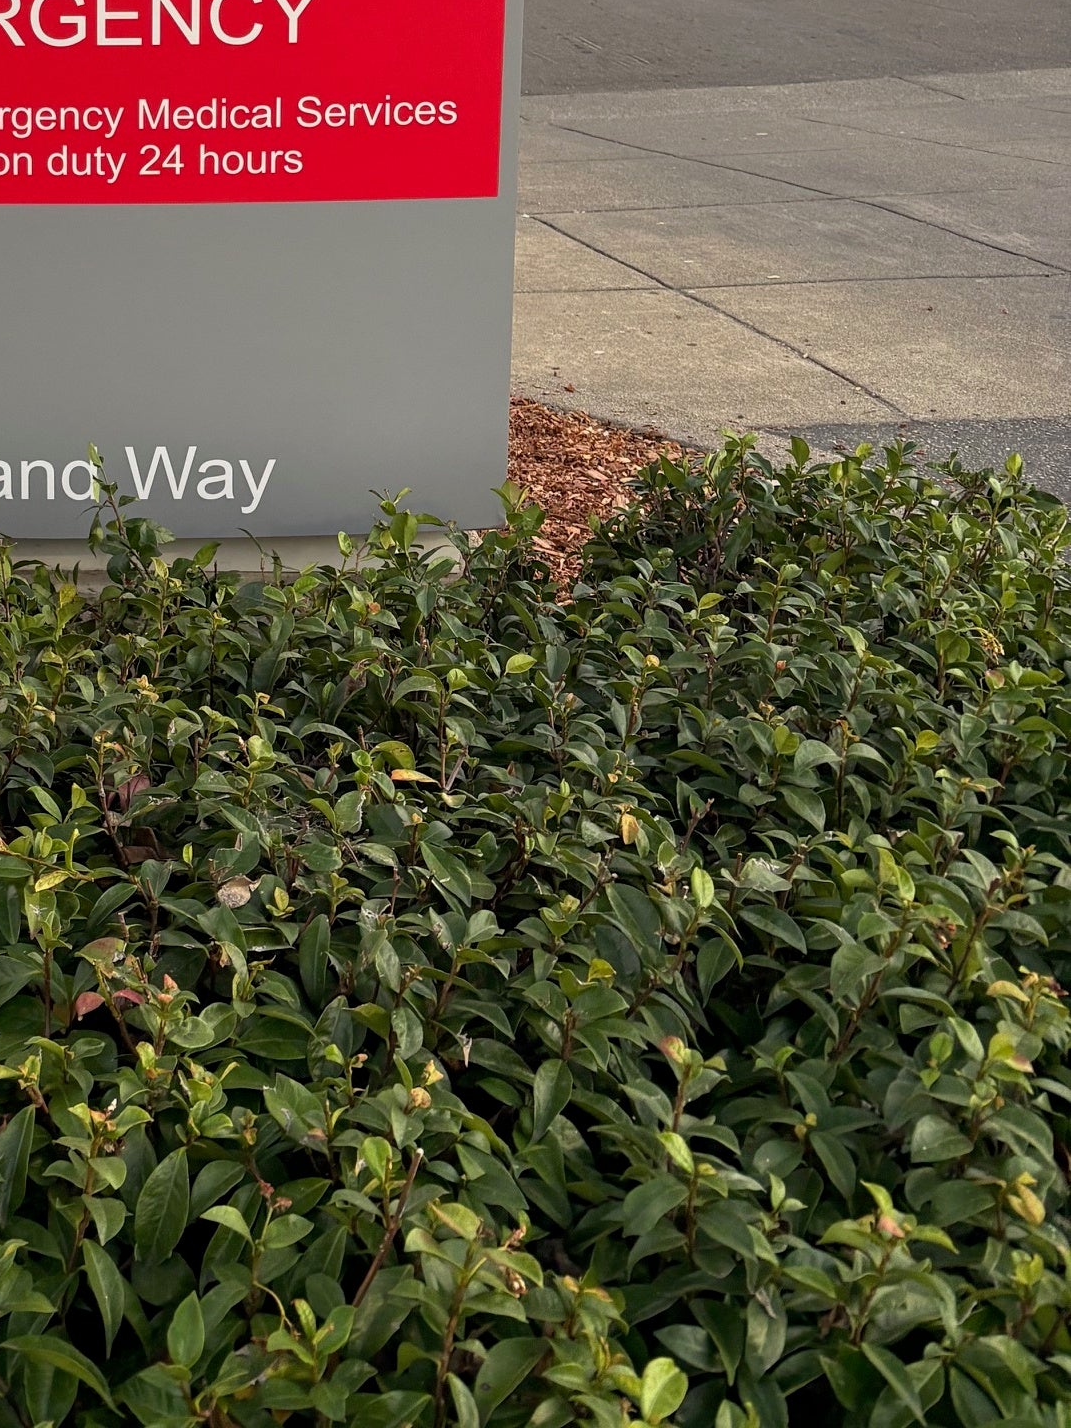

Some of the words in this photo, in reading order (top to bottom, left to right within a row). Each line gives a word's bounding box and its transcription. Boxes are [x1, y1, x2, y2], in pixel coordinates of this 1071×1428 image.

[138, 97, 282, 130] Medical
[296, 94, 458, 128] Services
[47, 145, 127, 184] duty
[139, 144, 185, 175] 24
[199, 144, 303, 175] hours
[124, 445, 277, 514] Way
